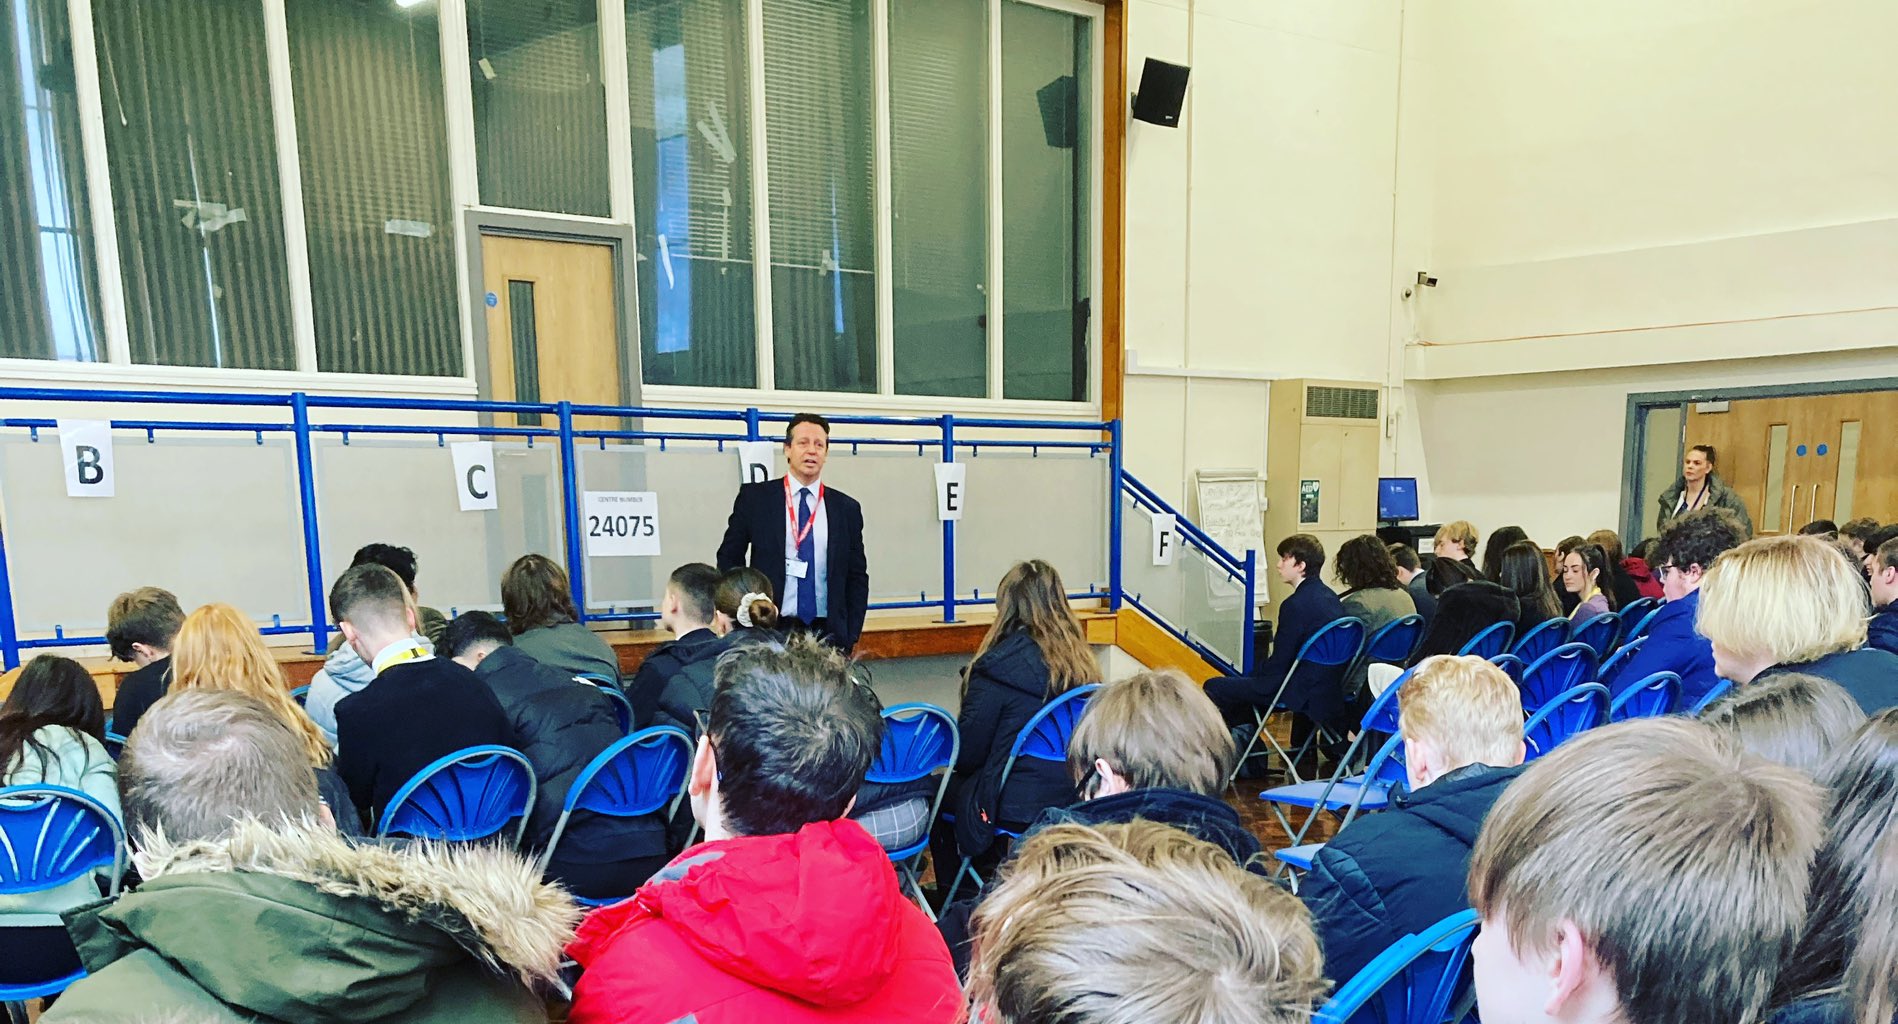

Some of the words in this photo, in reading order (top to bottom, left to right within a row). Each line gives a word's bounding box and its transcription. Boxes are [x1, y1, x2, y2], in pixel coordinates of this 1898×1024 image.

[76, 445, 104, 484] B
[467, 464, 488, 499] C
[1302, 485, 1313, 493] AED
[947, 482, 958, 511] E
[589, 515, 654, 537] 24075
[1160, 531, 1169, 557] F
